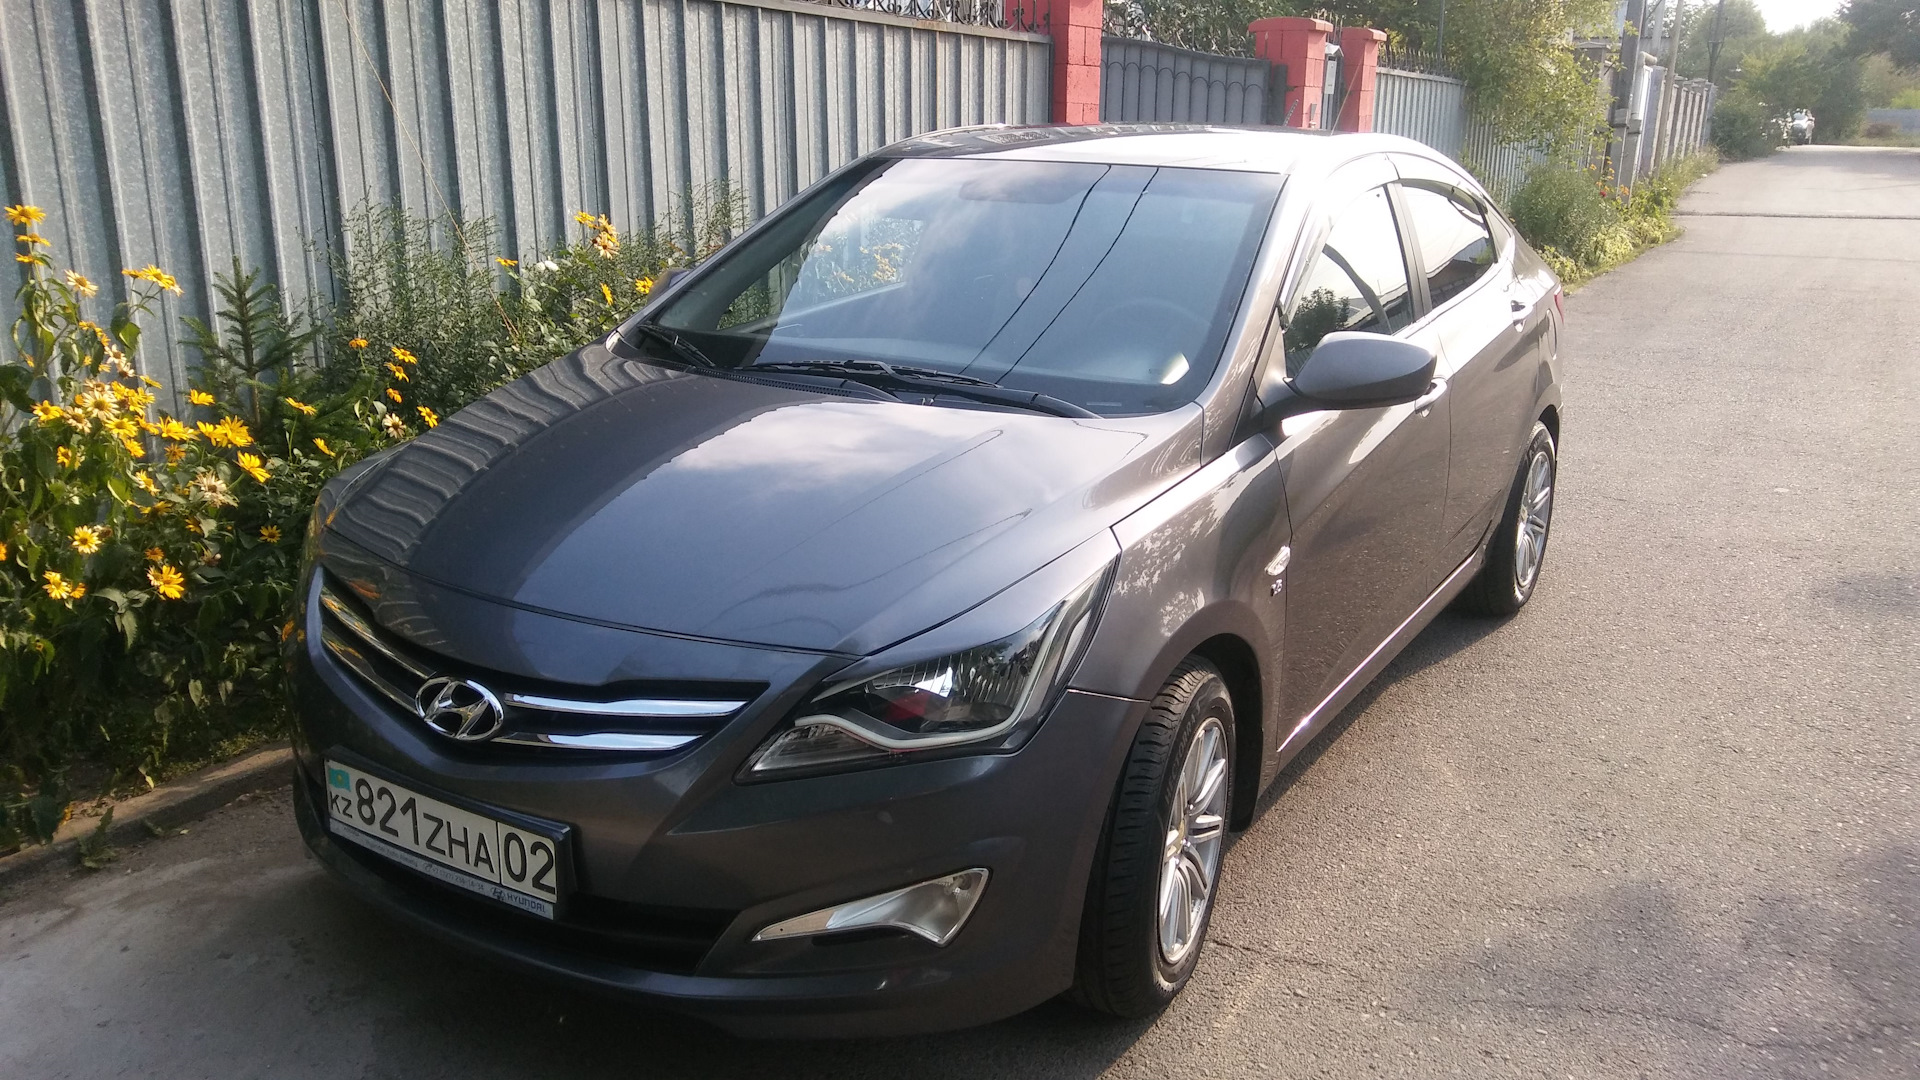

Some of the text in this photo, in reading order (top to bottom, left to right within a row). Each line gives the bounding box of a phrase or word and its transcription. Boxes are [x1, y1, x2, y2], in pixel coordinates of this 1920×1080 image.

[329, 791, 353, 819] KZ
[503, 832, 556, 895] 02
[506, 893, 546, 914] HYUNDAI
